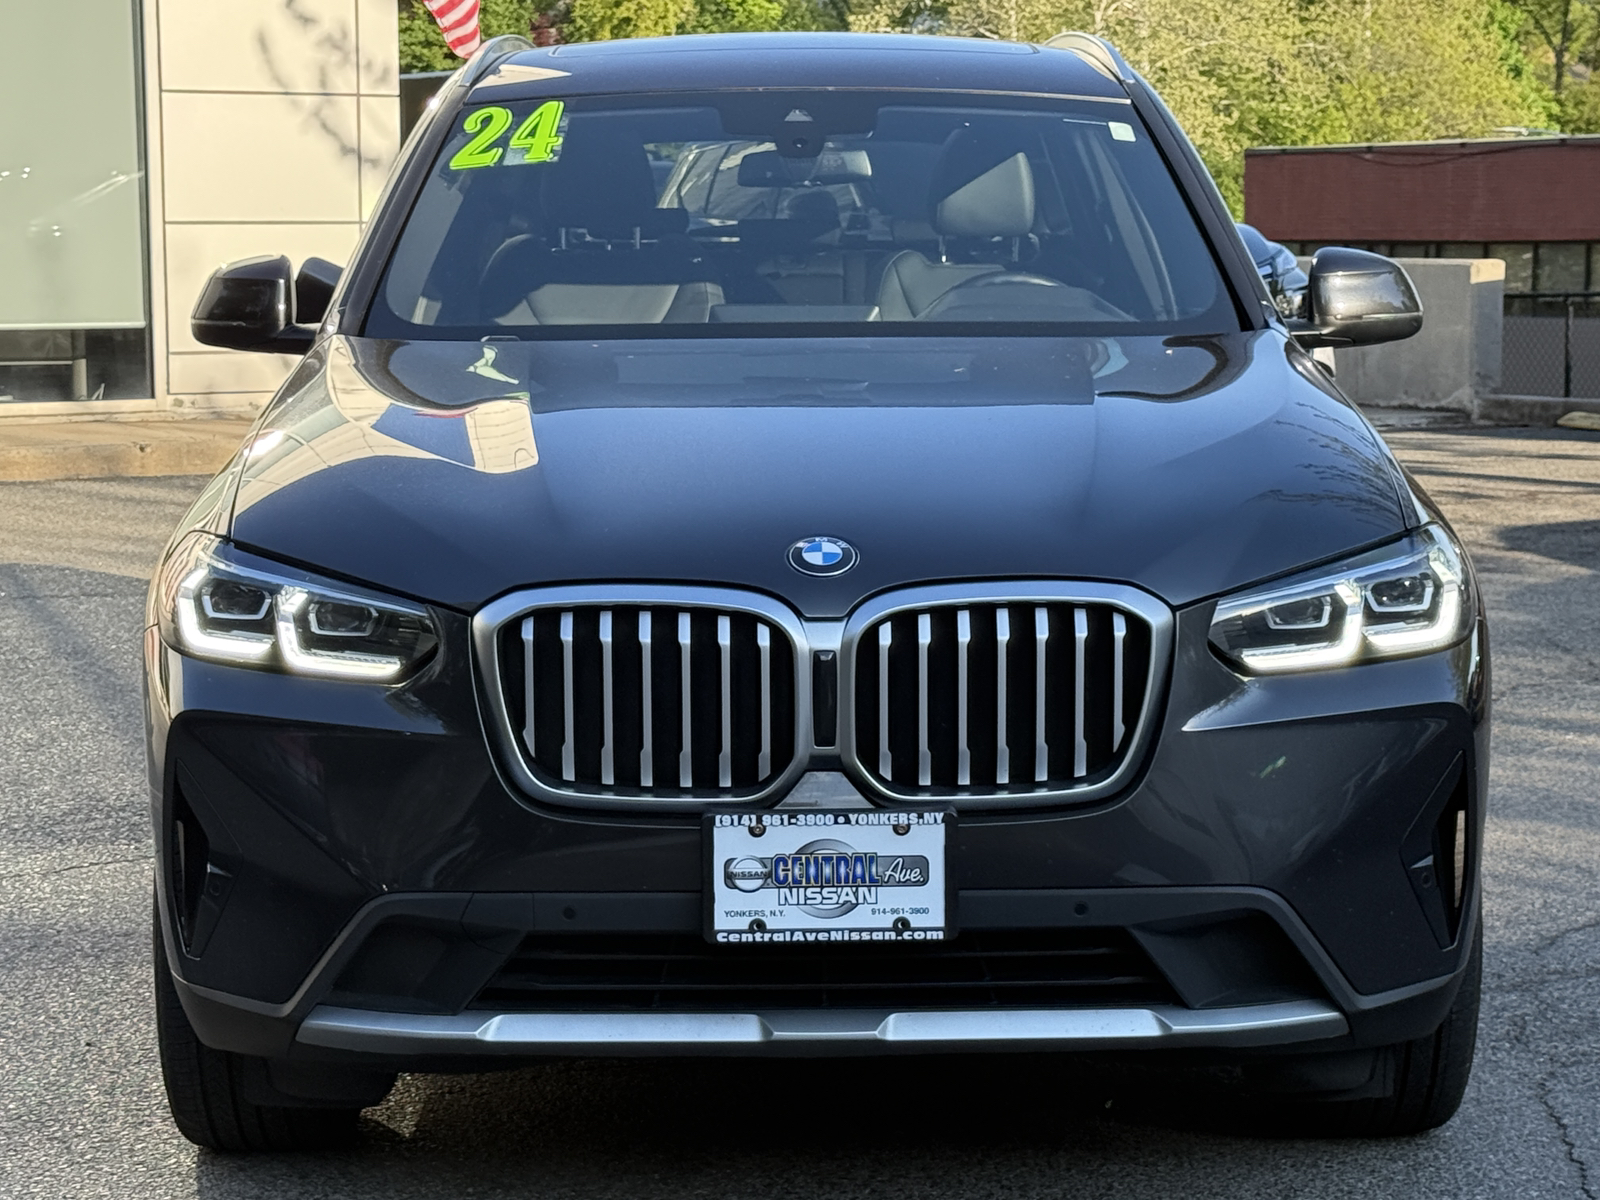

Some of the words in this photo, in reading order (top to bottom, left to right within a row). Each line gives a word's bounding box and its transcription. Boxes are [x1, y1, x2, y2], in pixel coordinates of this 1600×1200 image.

[449, 100, 565, 170] 24
[761, 813, 835, 827] 961-3900
[729, 870, 768, 878] NISSAN
[772, 853, 882, 887] CENTRAL
[884, 857, 924, 883] Ave.
[778, 886, 878, 906] NISSAN
[724, 909, 769, 919] YONKERS,
[769, 909, 786, 918] N.Y.
[871, 906, 930, 916] 914-961-3900
[716, 929, 944, 943] CentralAveNissan.com
